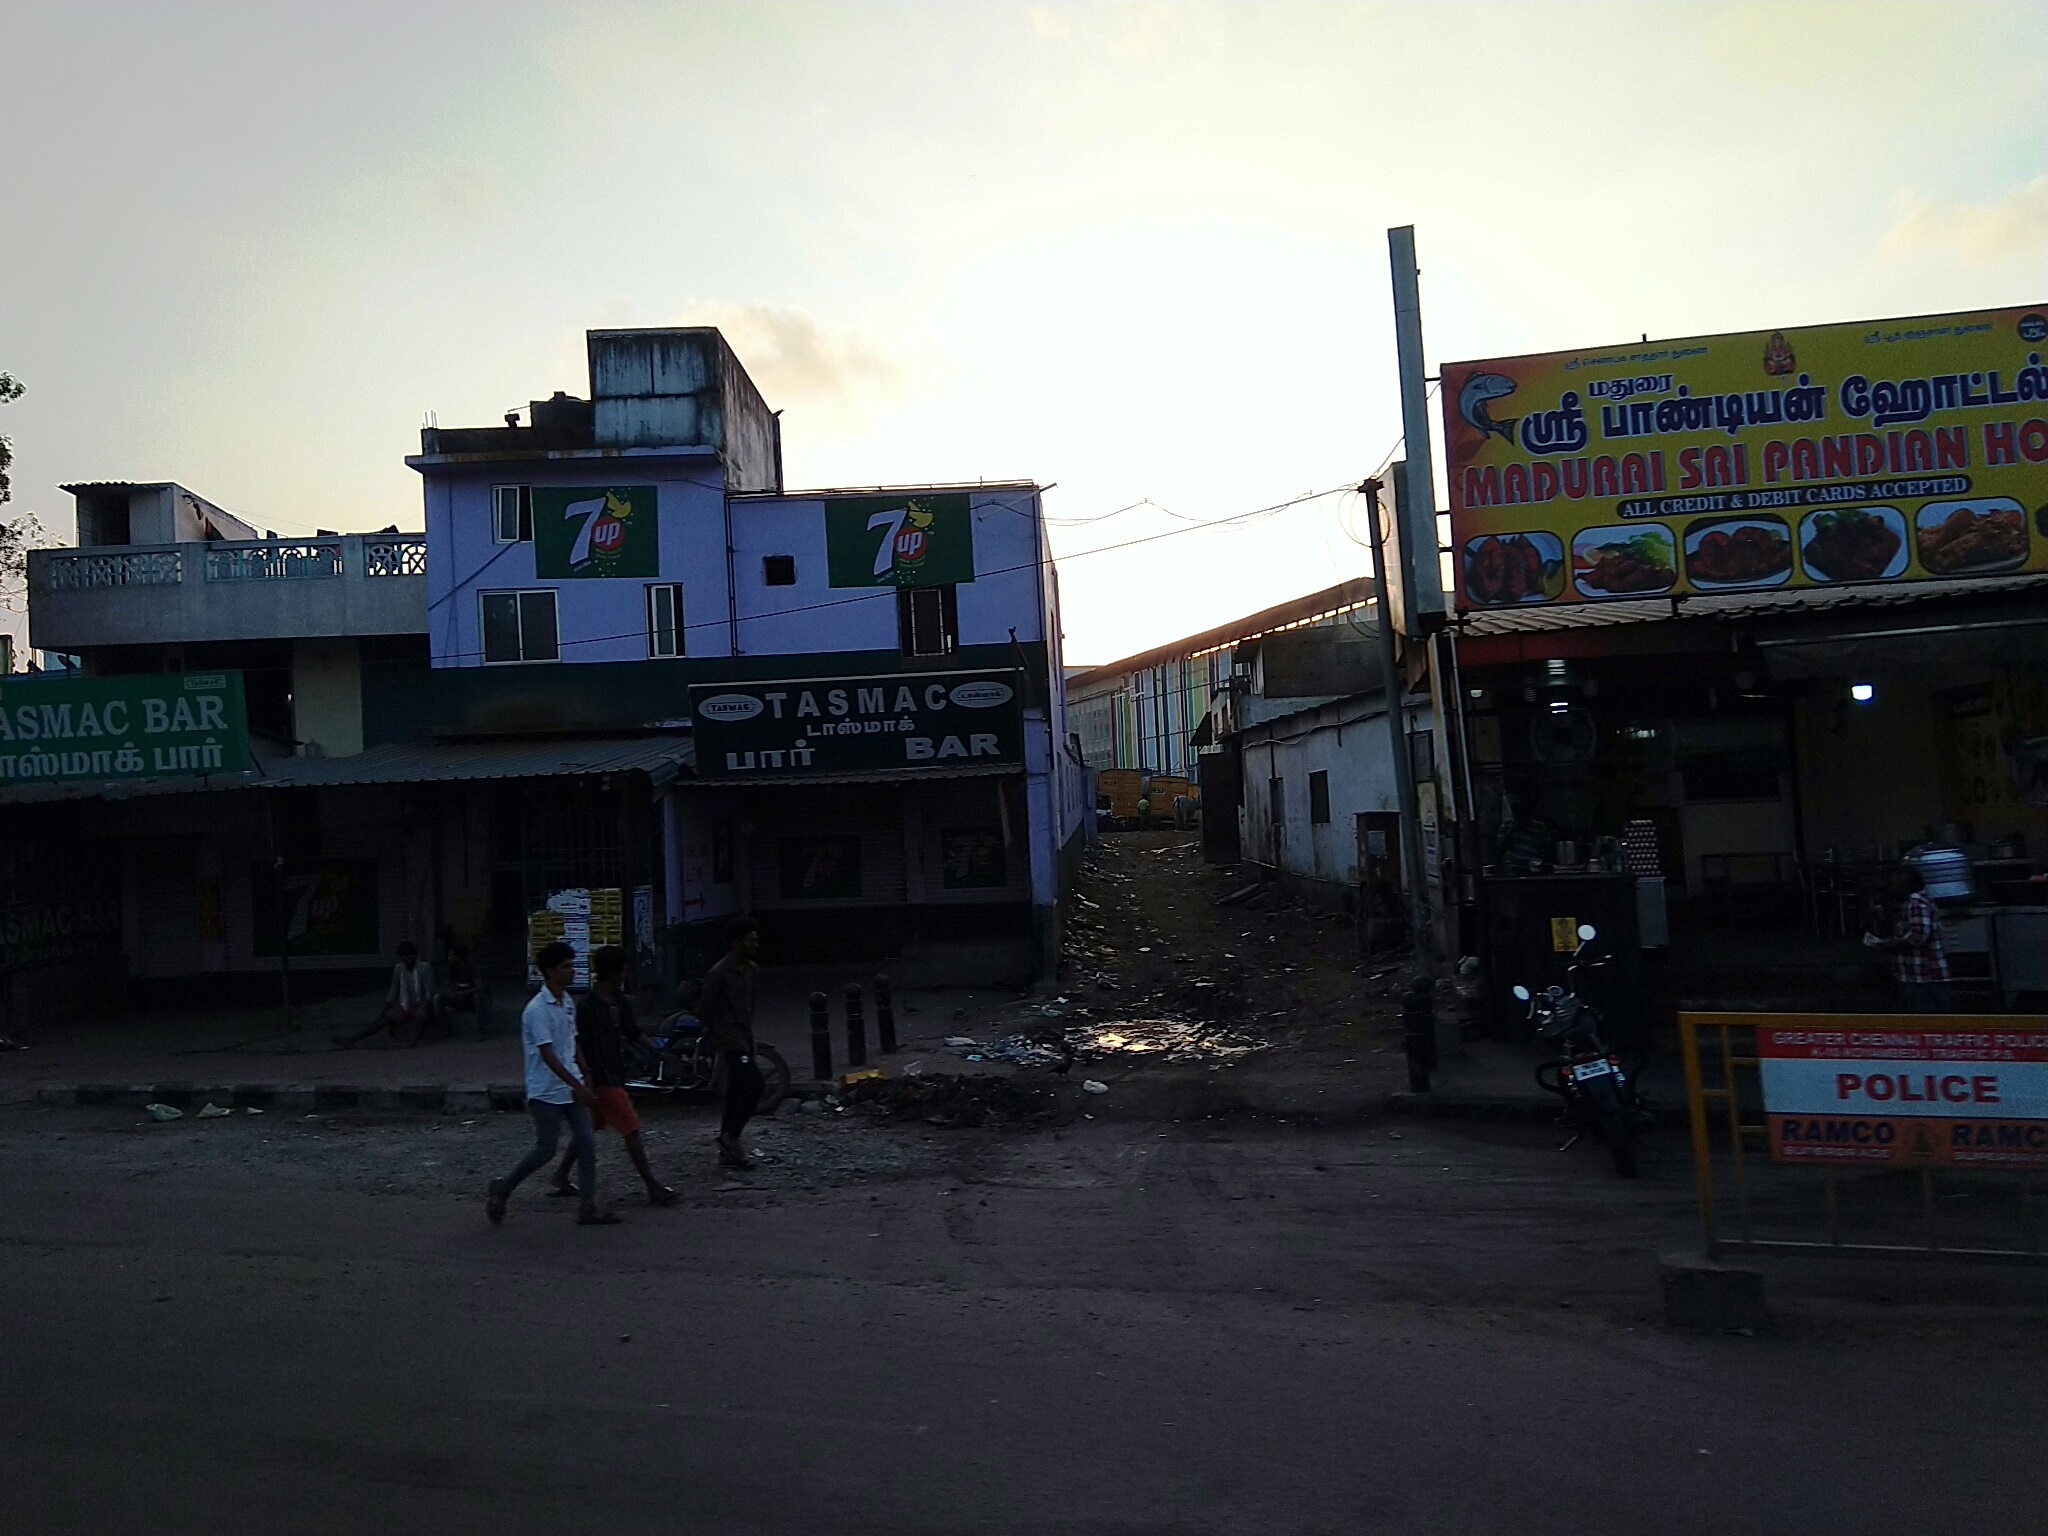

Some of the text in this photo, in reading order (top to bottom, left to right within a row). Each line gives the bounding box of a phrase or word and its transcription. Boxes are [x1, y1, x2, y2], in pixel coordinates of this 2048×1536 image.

[1588, 374, 1674, 400] மதுரை
[1603, 374, 1827, 438] பாண்டியன்
[1464, 451, 1665, 508] MADURAI
[1679, 444, 1747, 490] SRI
[1764, 426, 1969, 484] PANDIAN
[1622, 477, 1967, 517] ALL CREDIT & DEBIT CARDS ACCEPTED
[142, 695, 228, 734] BAR
[765, 684, 948, 719] TASMAC
[806, 715, 915, 737] டாஸ்மாக்
[153, 737, 224, 771] பார்
[726, 738, 816, 770] பார்
[905, 733, 1001, 760] BAR
[1772, 1032, 1846, 1045] GREATER
[1922, 1033, 1990, 1047] TRAFFIC
[1836, 1073, 2001, 1104] POLICE
[1782, 1120, 2046, 1148] RAMCO RAMC
